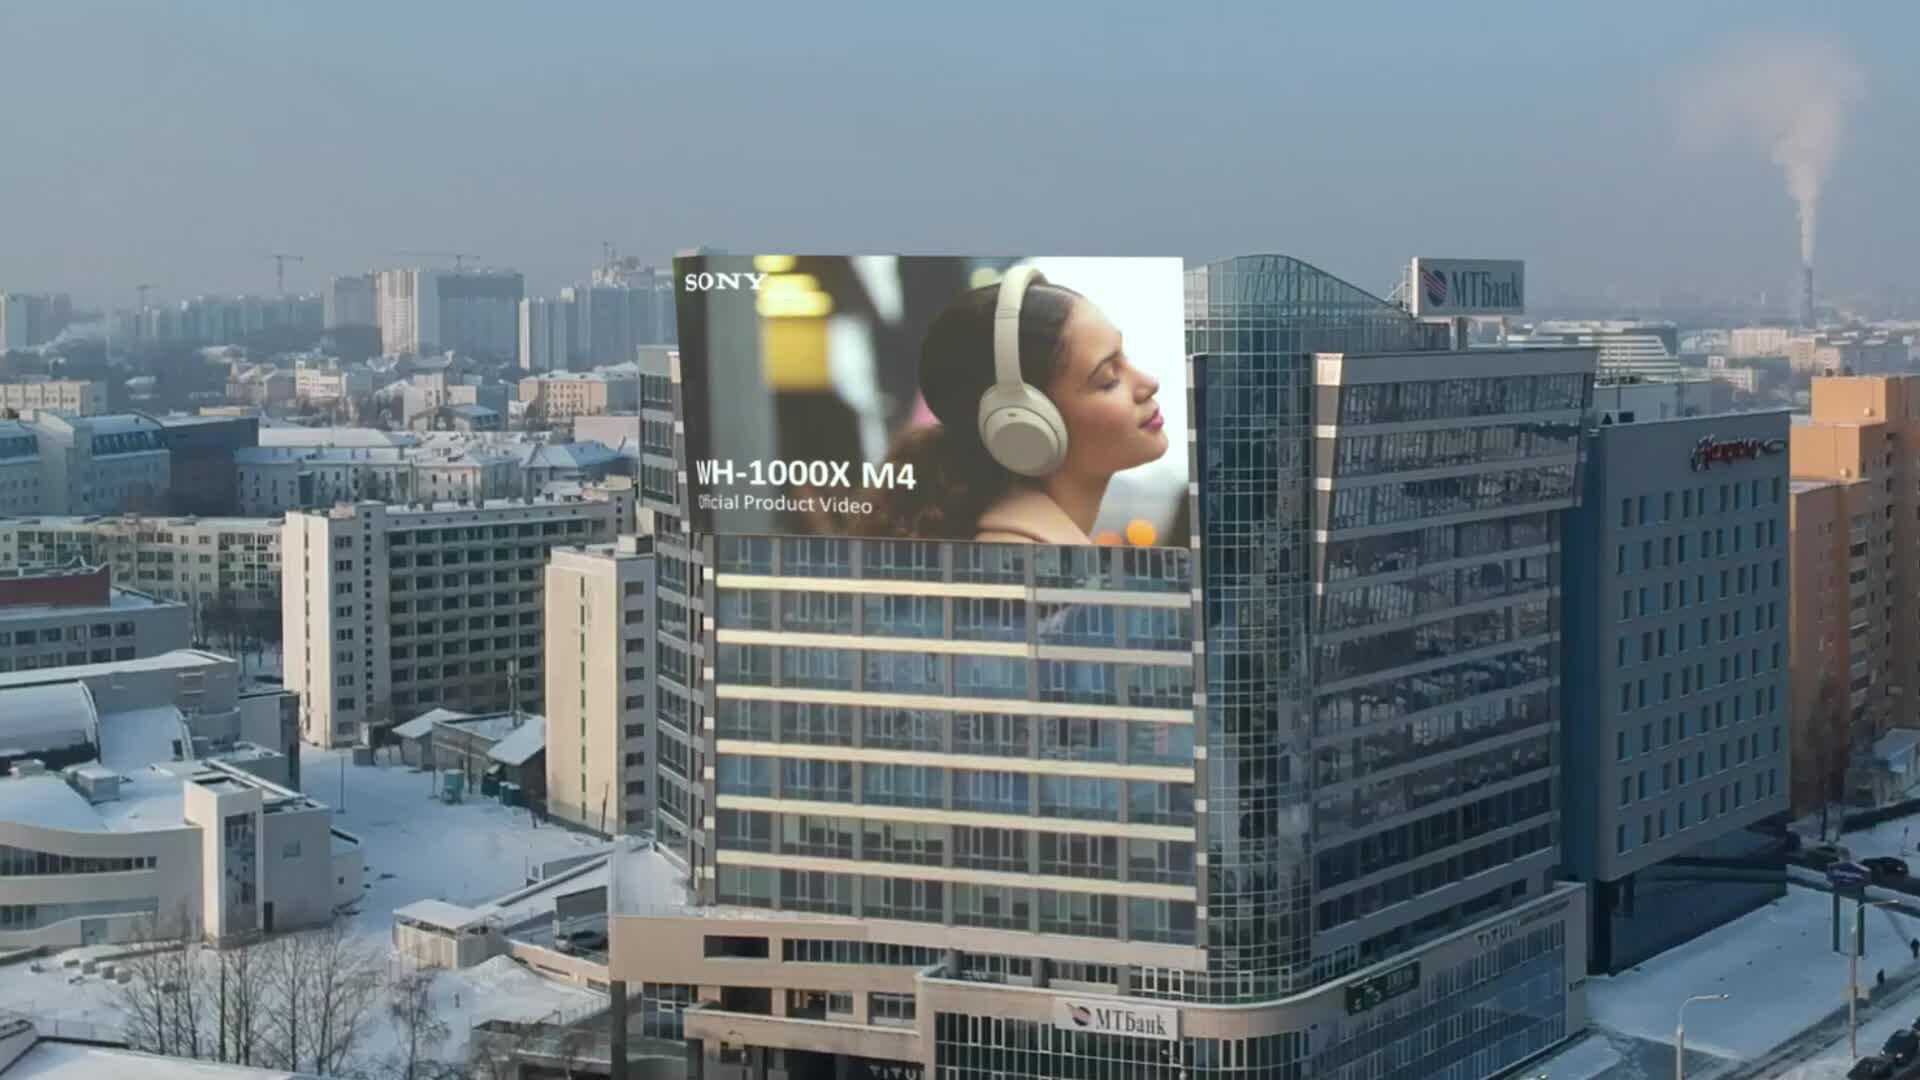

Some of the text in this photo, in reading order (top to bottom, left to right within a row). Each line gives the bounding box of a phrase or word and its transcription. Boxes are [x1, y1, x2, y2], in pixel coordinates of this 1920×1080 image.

[684, 272, 769, 291] SONY
[695, 459, 917, 490] WH-1000X M4
[744, 495, 815, 512] Product
[820, 497, 873, 514] Video
